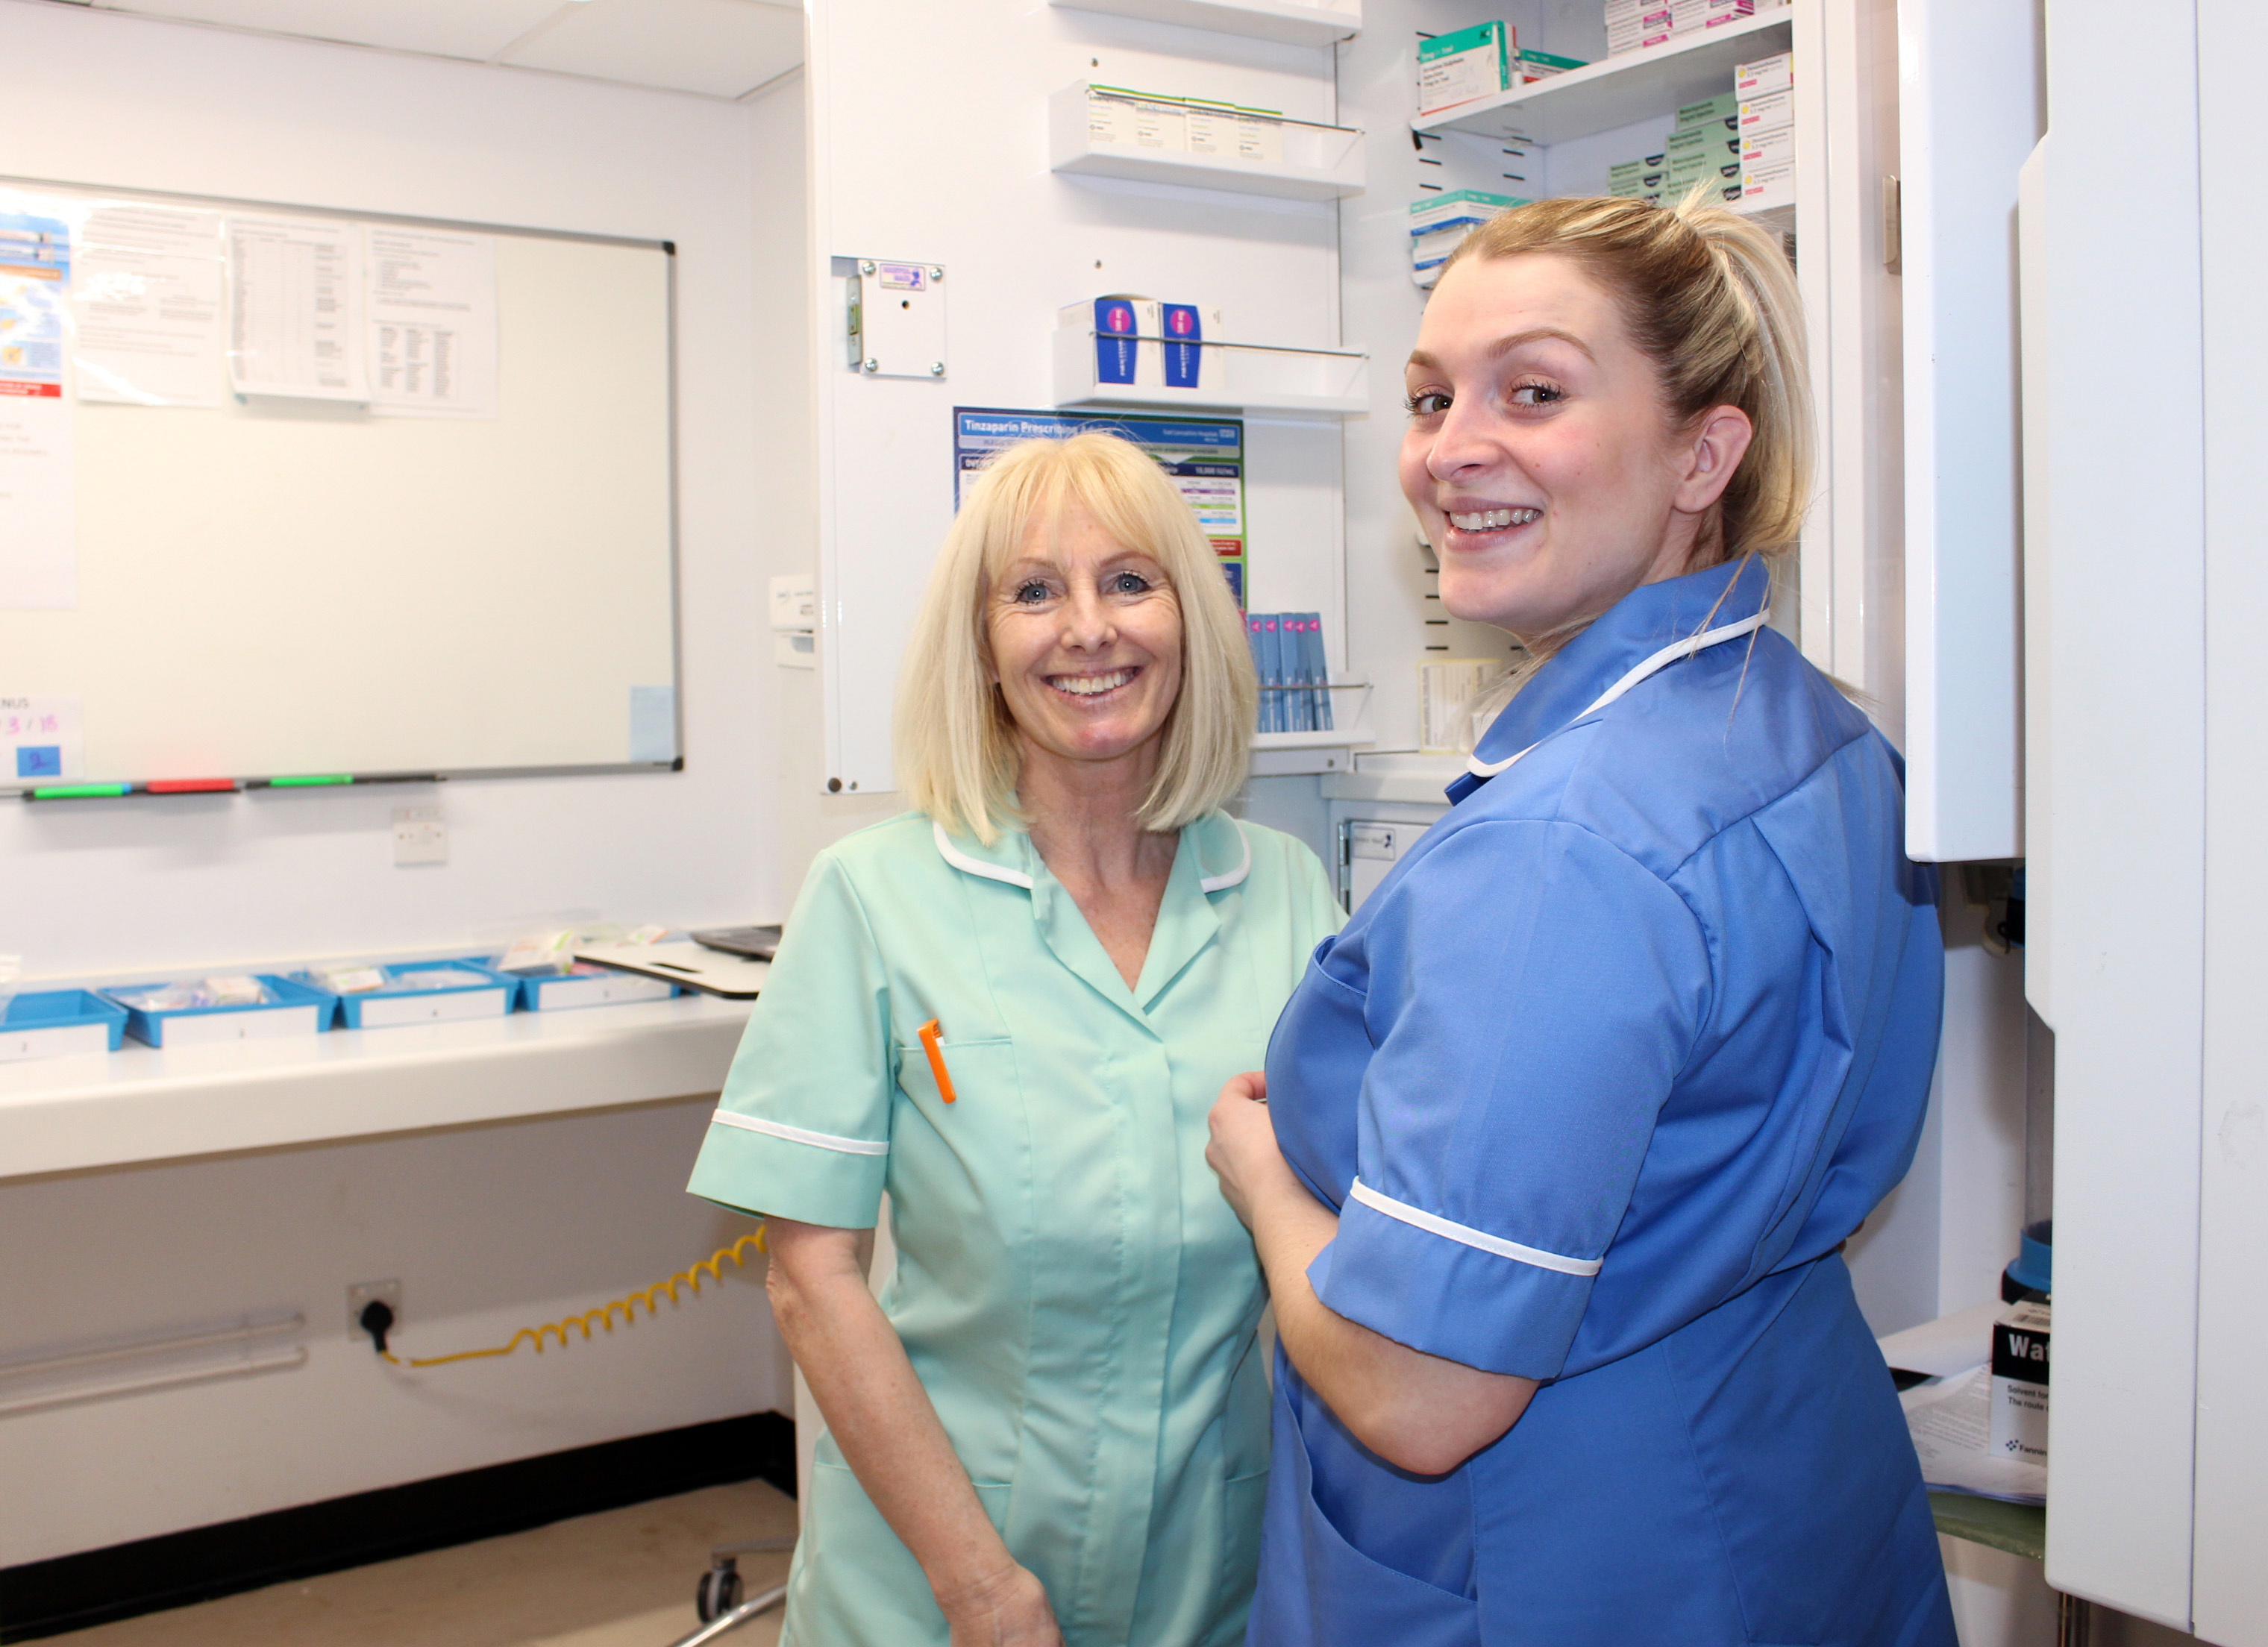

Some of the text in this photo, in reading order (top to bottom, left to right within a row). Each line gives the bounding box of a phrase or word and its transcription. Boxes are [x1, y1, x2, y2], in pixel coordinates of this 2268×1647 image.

[965, 419, 1020, 434] Tinzaparin
[2007, 1384, 2037, 1398] Solvent
[2008, 1396, 2022, 1408] The
[2023, 1400, 2044, 1411] route
